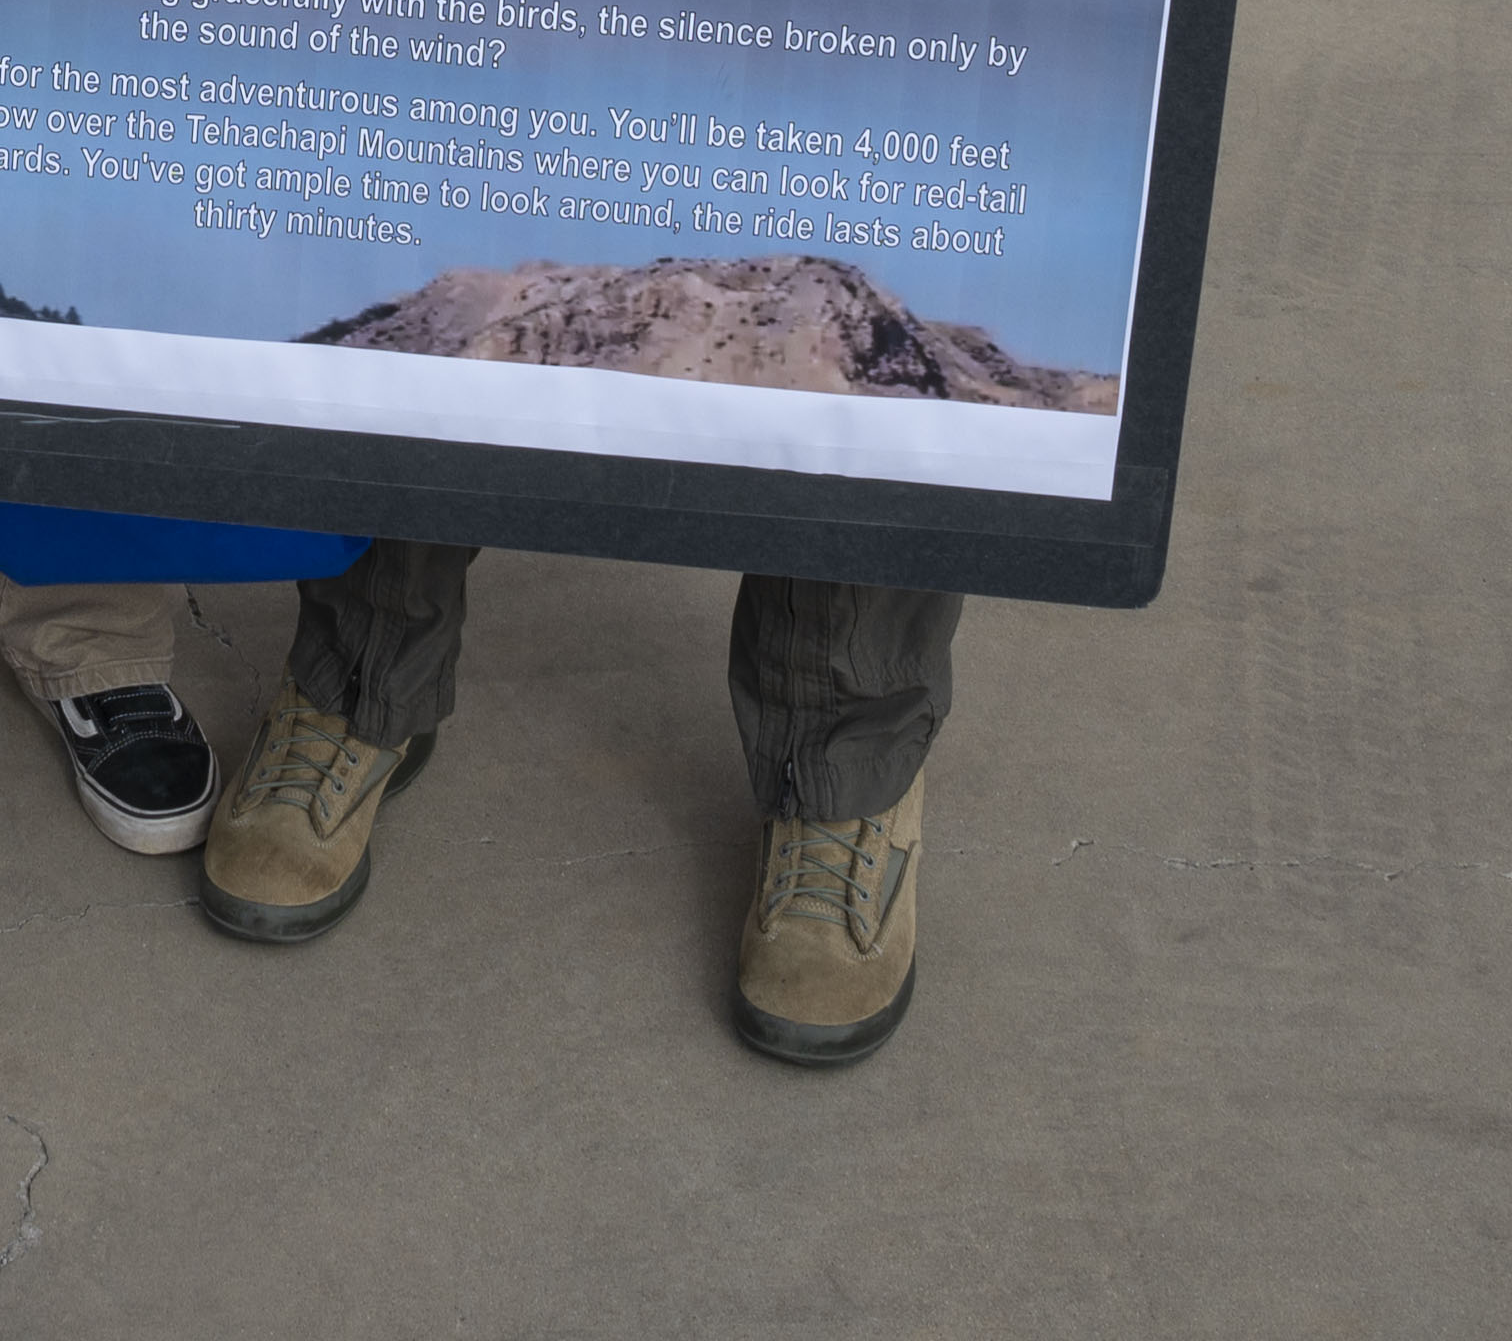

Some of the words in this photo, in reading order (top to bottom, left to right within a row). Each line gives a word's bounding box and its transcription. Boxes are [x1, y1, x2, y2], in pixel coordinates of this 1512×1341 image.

[138, 9, 190, 44] the
[197, 19, 300, 51] sound
[307, 21, 344, 54] of
[348, 24, 400, 60] the
[408, 36, 508, 70] wind?
[597, 4, 649, 39] the
[657, 9, 775, 50] silence
[783, 19, 898, 59] broken
[906, 31, 979, 73] only
[986, 35, 1029, 78] by
[50, 60, 102, 95] the
[109, 72, 192, 103] most
[198, 73, 400, 119] adventurous
[407, 96, 520, 139] among
[527, 107, 597, 141] you.
[706, 114, 747, 150] be
[754, 120, 844, 158] taken
[852, 126, 940, 165] 4,000
[948, 134, 1012, 172] feet
[45, 109, 119, 138] over
[124, 109, 176, 143] the
[184, 112, 348, 162] Tehachapi
[356, 126, 525, 174] Mountains
[533, 146, 633, 184] where
[640, 160, 702, 193] you
[710, 166, 770, 195] can
[779, 164, 850, 202] look
[857, 170, 907, 206] for
[912, 178, 1028, 216] red-tail
[193, 197, 278, 240] thirty
[285, 210, 422, 246] minutes.
[194, 159, 248, 195] got
[254, 165, 352, 202] ample
[360, 171, 431, 206] time
[438, 178, 472, 210] to
[480, 180, 550, 218] look
[557, 195, 682, 231] around,
[691, 201, 744, 236] the
[752, 208, 815, 242] ride
[824, 211, 901, 249] lasts
[910, 219, 1006, 257] about
